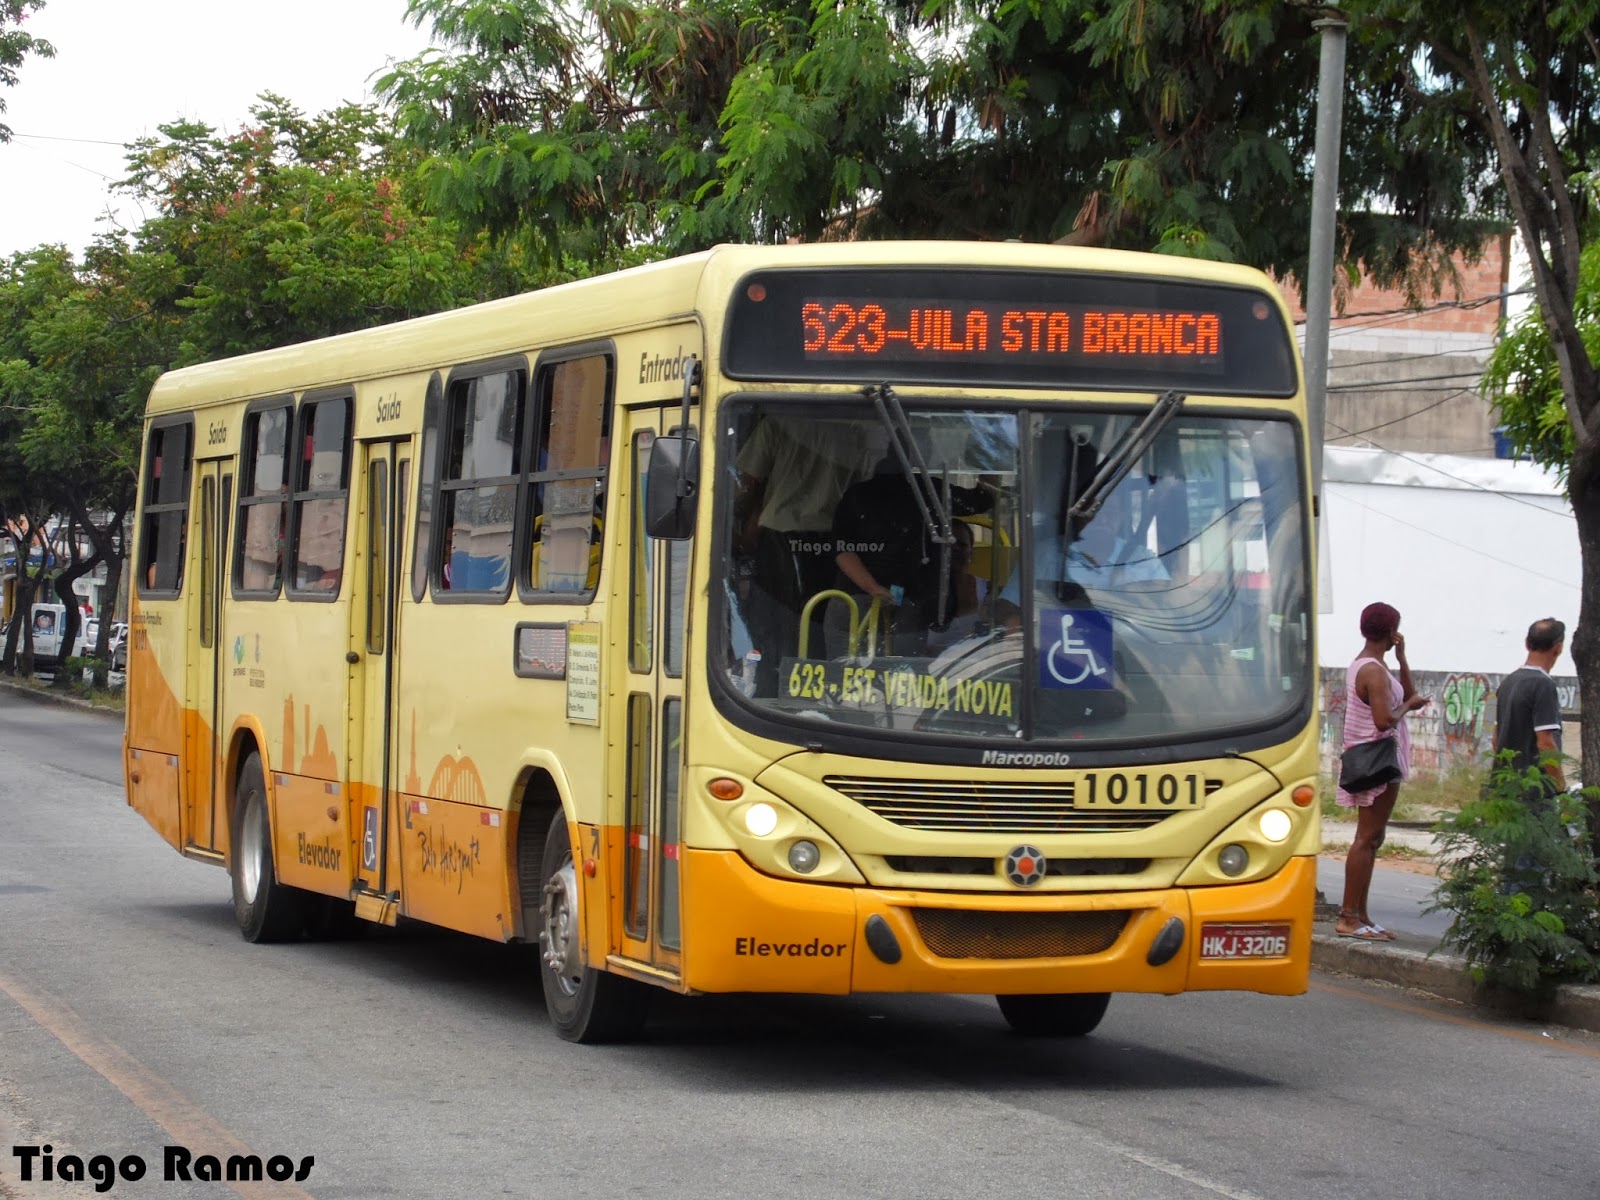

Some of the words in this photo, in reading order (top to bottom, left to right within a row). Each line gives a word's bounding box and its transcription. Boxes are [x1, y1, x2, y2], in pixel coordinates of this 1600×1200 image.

[1002, 311, 1069, 352] STA
[1083, 312, 1218, 354] BRANCA
[376, 391, 401, 423] Saída
[208, 418, 227, 445] Saída
[788, 662, 826, 699] 623
[842, 667, 877, 704] EST.
[882, 671, 950, 711] VENDA
[955, 678, 1013, 717] NOVA
[981, 750, 1070, 767] Marcopolo
[1083, 773, 1197, 805] 10101
[297, 832, 341, 871] Elevador
[735, 937, 847, 957] Elevador
